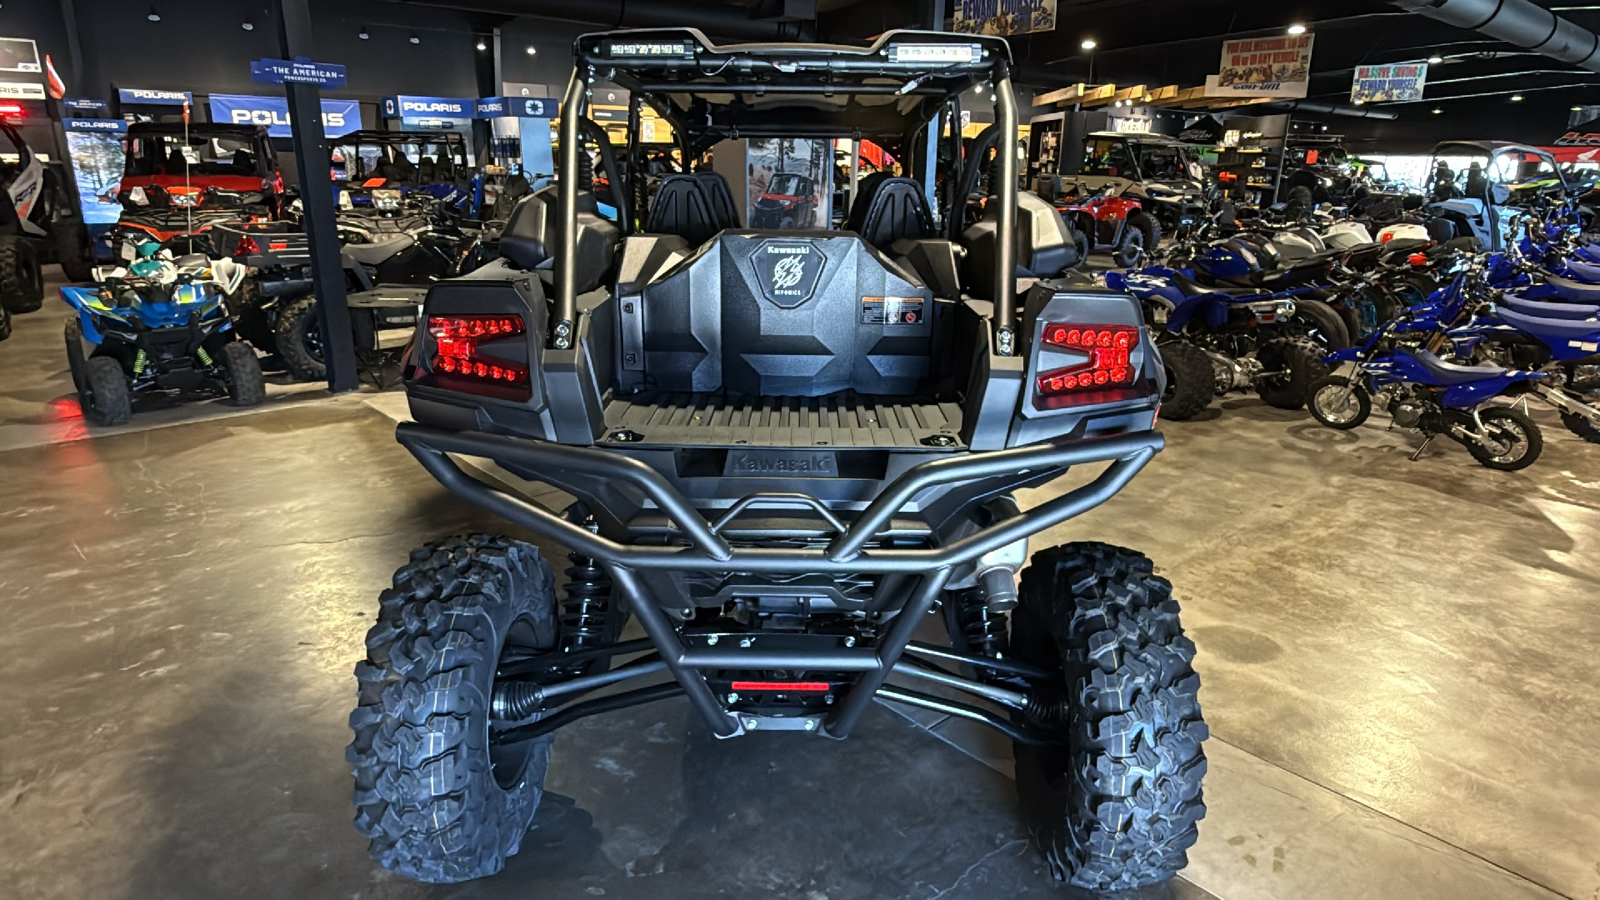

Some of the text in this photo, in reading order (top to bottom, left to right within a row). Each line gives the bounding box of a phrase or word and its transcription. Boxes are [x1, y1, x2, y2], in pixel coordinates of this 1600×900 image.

[272, 66, 337, 78] THE AMERICAN
[133, 91, 186, 100] POLARIS
[403, 102, 462, 113] POLARIS
[477, 103, 503, 112] POLARIS
[231, 109, 345, 127] POLIS
[71, 121, 119, 129] POLARIS
[767, 246, 810, 254] Kawasaki
